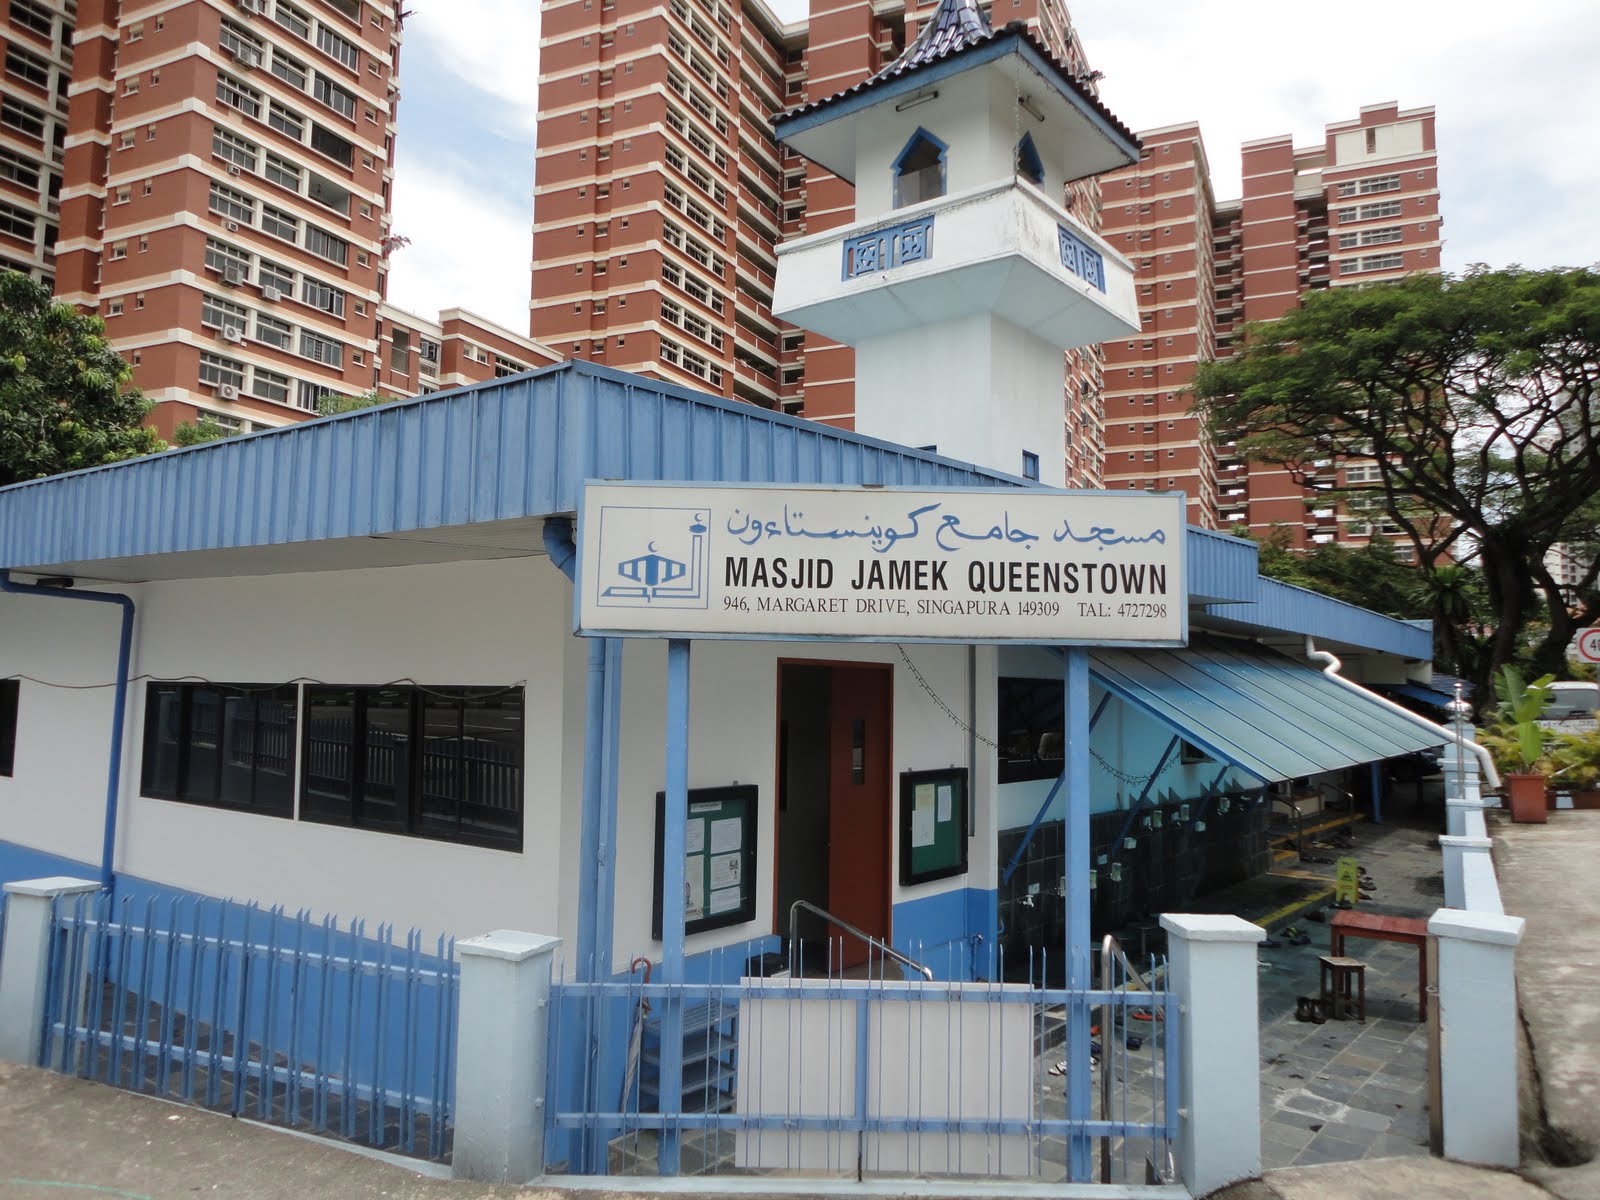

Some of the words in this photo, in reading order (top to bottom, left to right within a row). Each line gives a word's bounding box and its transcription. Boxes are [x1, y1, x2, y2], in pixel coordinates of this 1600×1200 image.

[935, 510, 1040, 552] جامع
[1053, 519, 1166, 552] مسجد
[725, 556, 834, 589] MASJID
[851, 559, 948, 591] JAMEK
[968, 560, 1167, 595] QUEENSTOWN
[723, 595, 750, 614] 946,
[757, 596, 849, 613] MARGARET
[856, 598, 910, 617] DRIVE,
[917, 599, 1011, 616] SINGAPURA
[1018, 600, 1060, 616] 149309
[1077, 602, 1112, 617] TAL:
[1117, 603, 1167, 618] 4727298
[1589, 638, 1600, 652] 4
